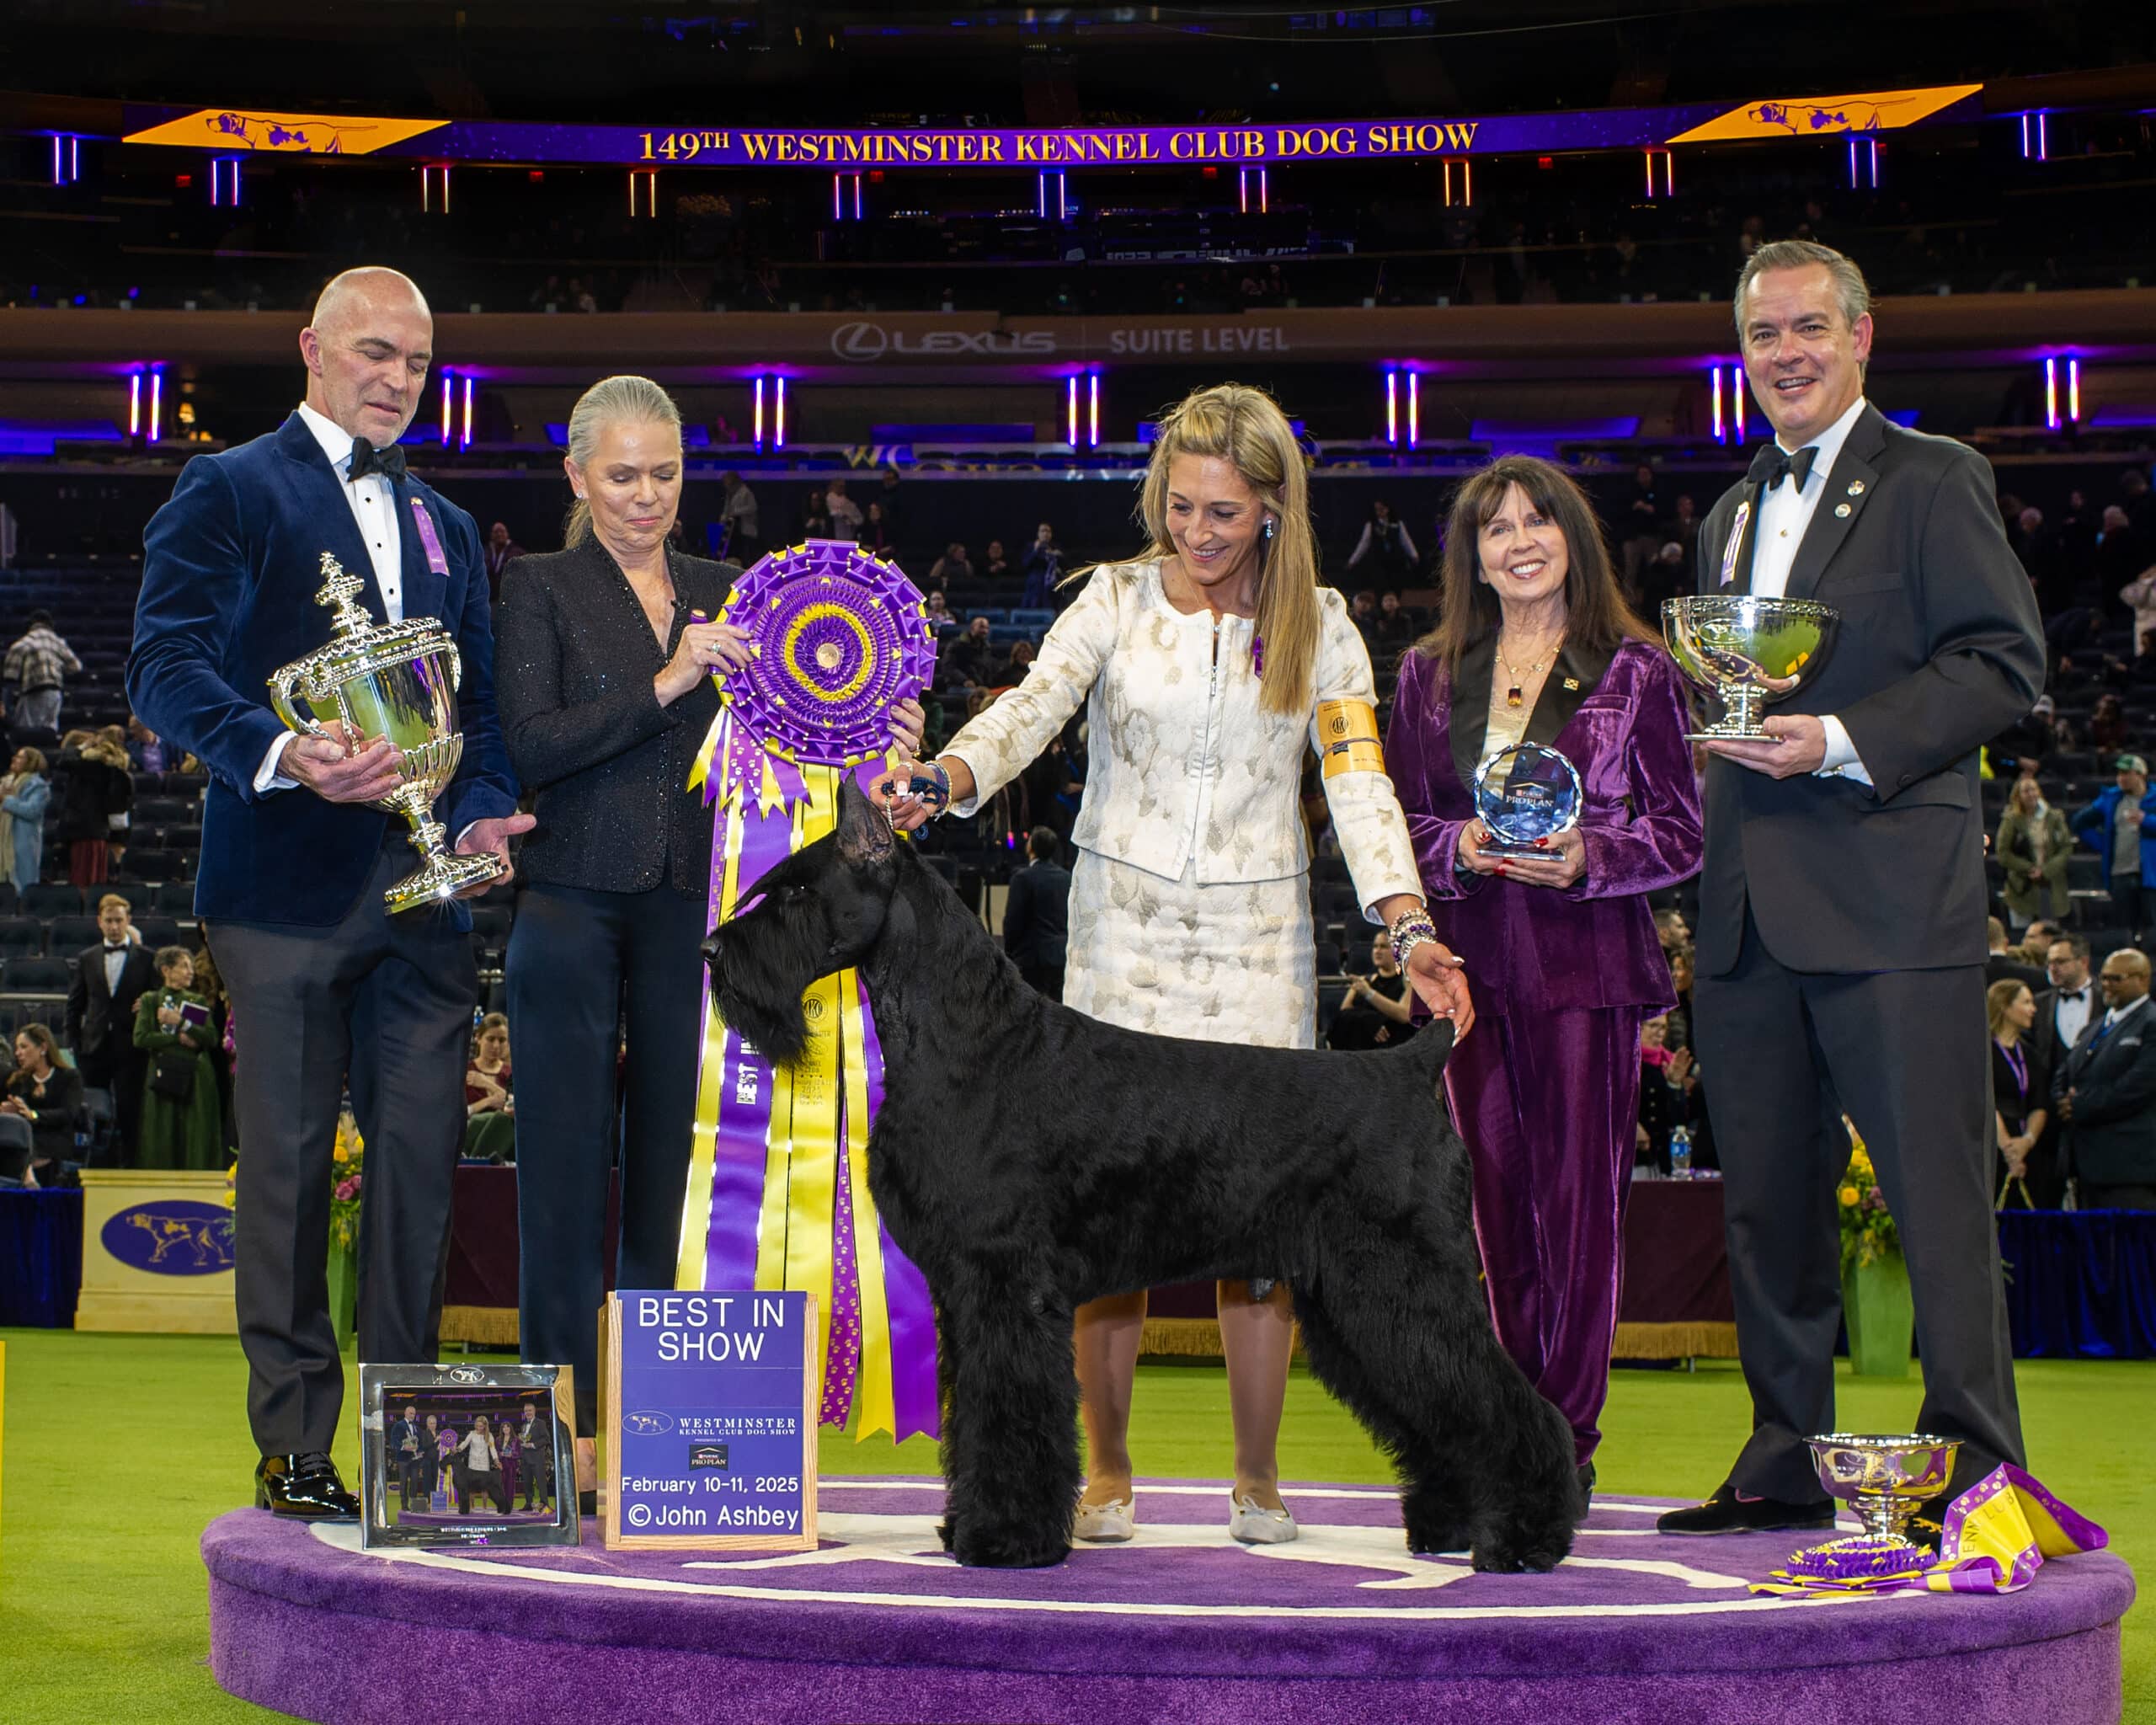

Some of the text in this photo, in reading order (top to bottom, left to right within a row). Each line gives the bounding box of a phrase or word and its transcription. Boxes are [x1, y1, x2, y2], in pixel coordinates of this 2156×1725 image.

[639, 122, 1479, 162] 149TH WESTMINSTER KENNEL CLUB DOG SHOW
[893, 331, 1057, 353] LEXUS
[1109, 326, 1290, 355] SUITE LEVEL
[735, 1062, 759, 1105] BEST
[639, 1297, 784, 1327] BEST IN
[658, 1331, 765, 1362] SHOW
[680, 1418, 796, 1429] WESTMINSTER
[622, 1477, 798, 1495] February 10-11, 2025
[717, 1504, 799, 1530] Ashbey
